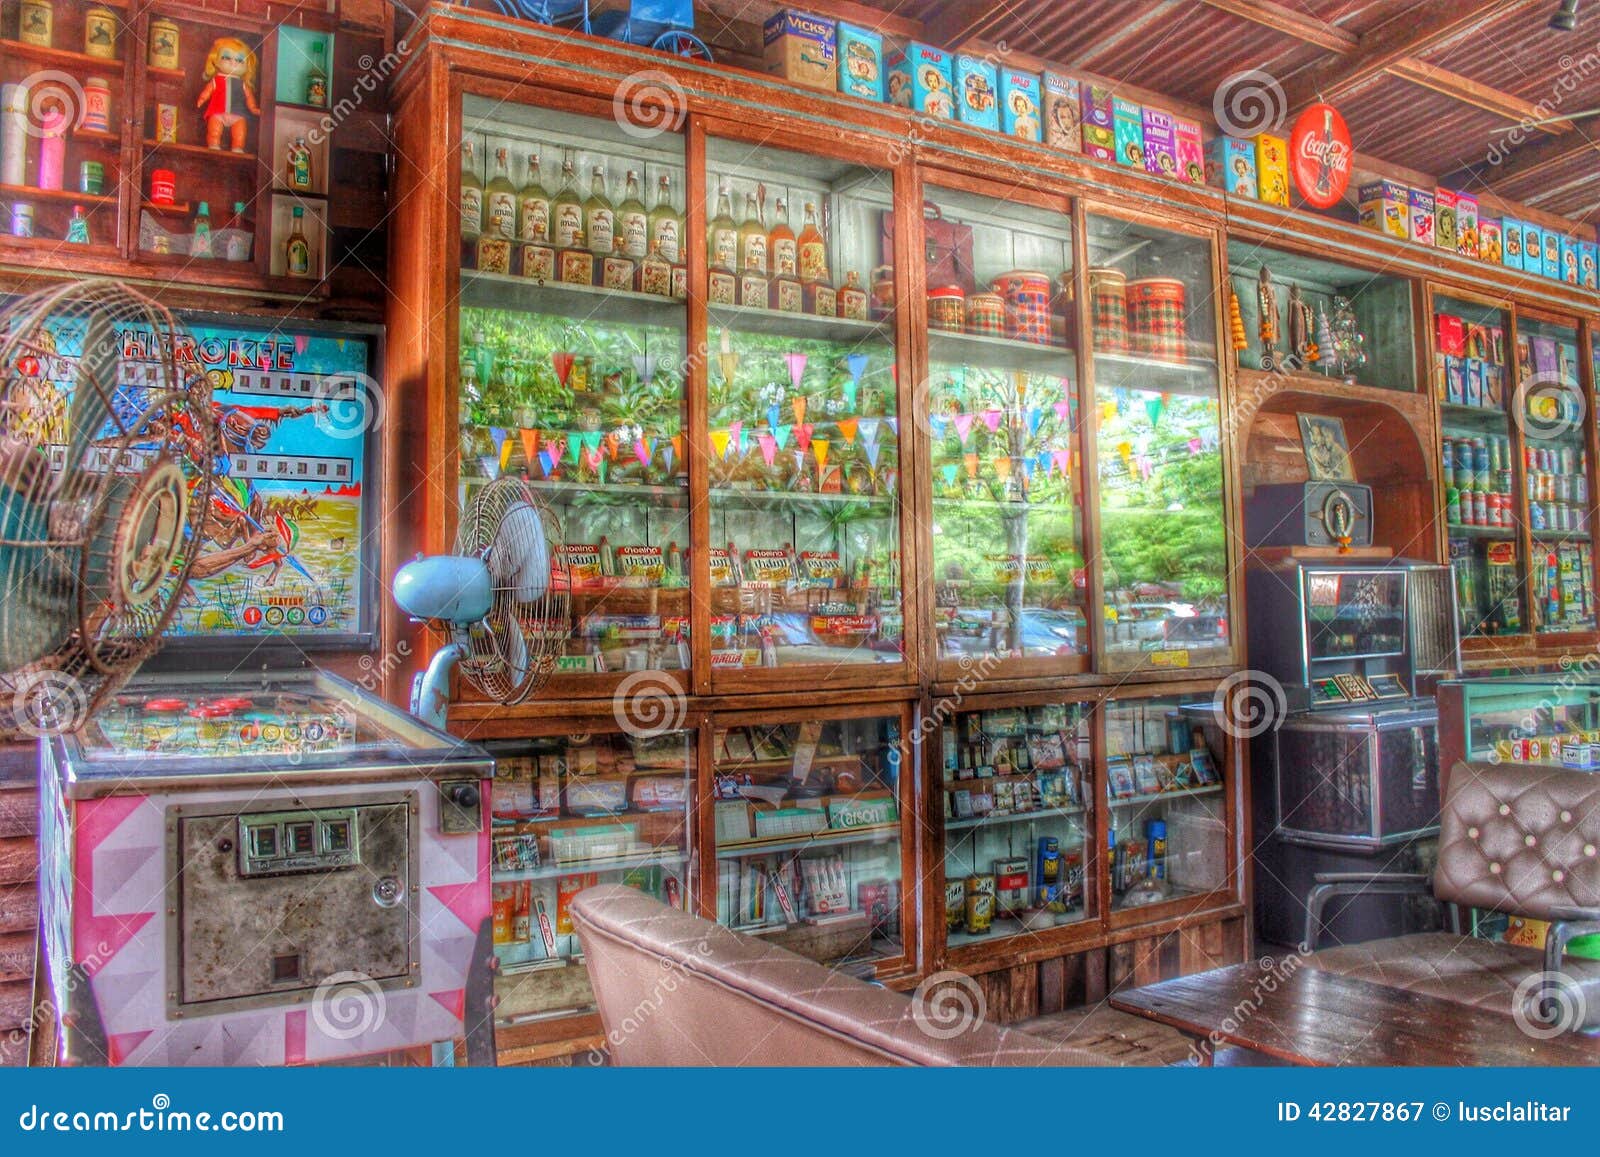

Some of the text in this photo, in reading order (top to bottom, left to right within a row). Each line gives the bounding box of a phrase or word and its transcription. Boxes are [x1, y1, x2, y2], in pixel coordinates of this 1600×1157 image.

[788, 16, 825, 35] VICKS
[1300, 131, 1350, 173] Coca-Cola
[113, 330, 297, 370] HEROKEE
